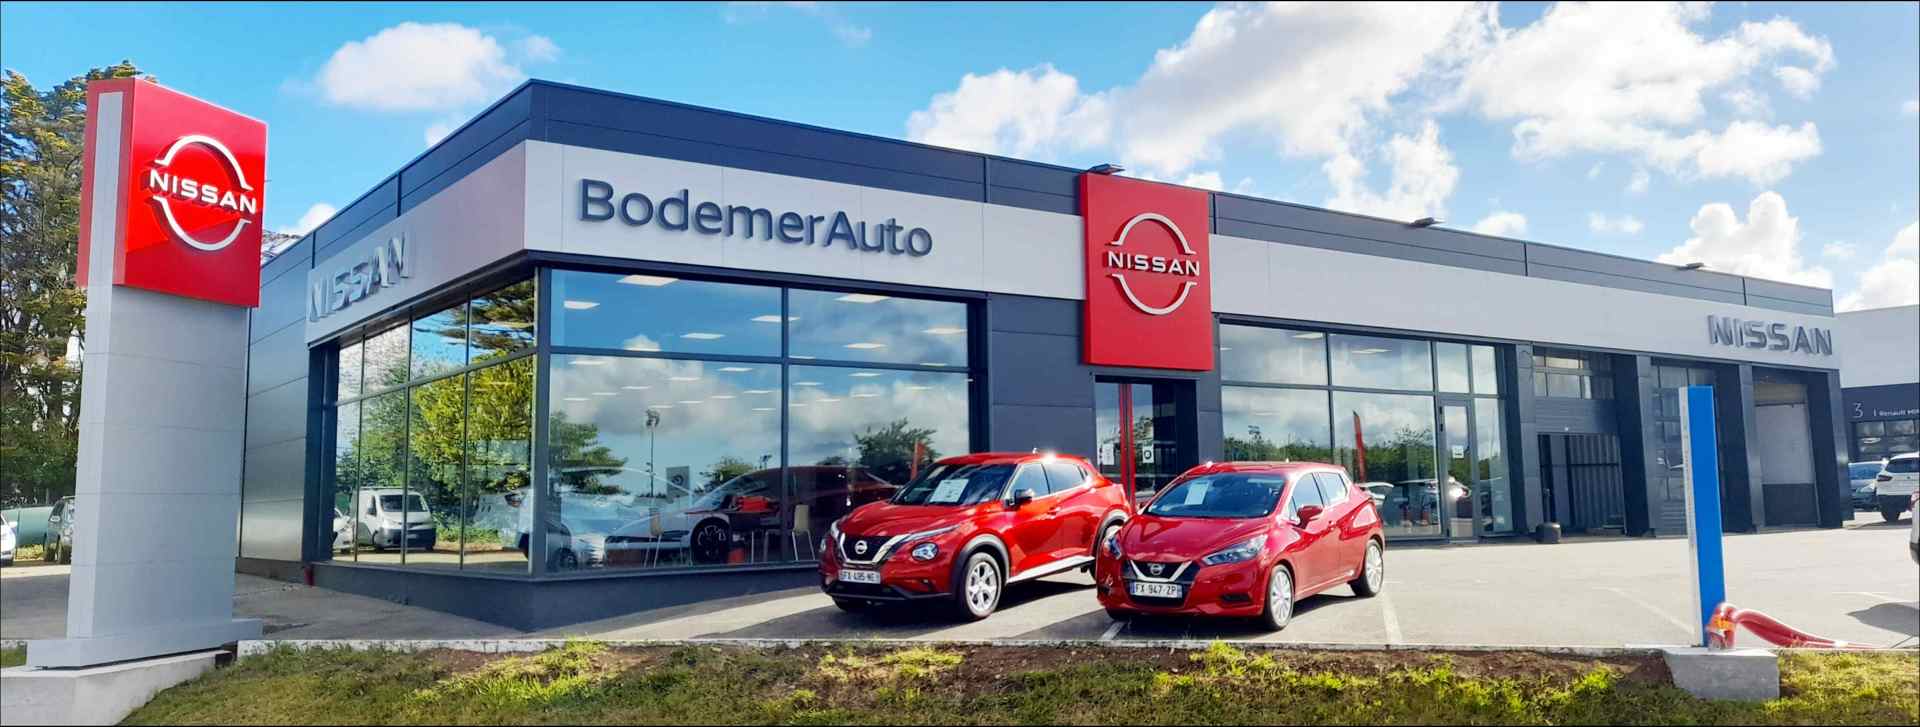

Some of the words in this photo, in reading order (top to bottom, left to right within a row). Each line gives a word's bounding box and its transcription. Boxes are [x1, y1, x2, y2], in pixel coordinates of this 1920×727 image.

[150, 168, 257, 214] NISSAN
[579, 178, 934, 257] BodemerAuto
[306, 236, 409, 322] NISSAN
[1107, 251, 1201, 276] NISSAN
[1706, 314, 1833, 355] NISSAN
[1852, 402, 1864, 418] 3
